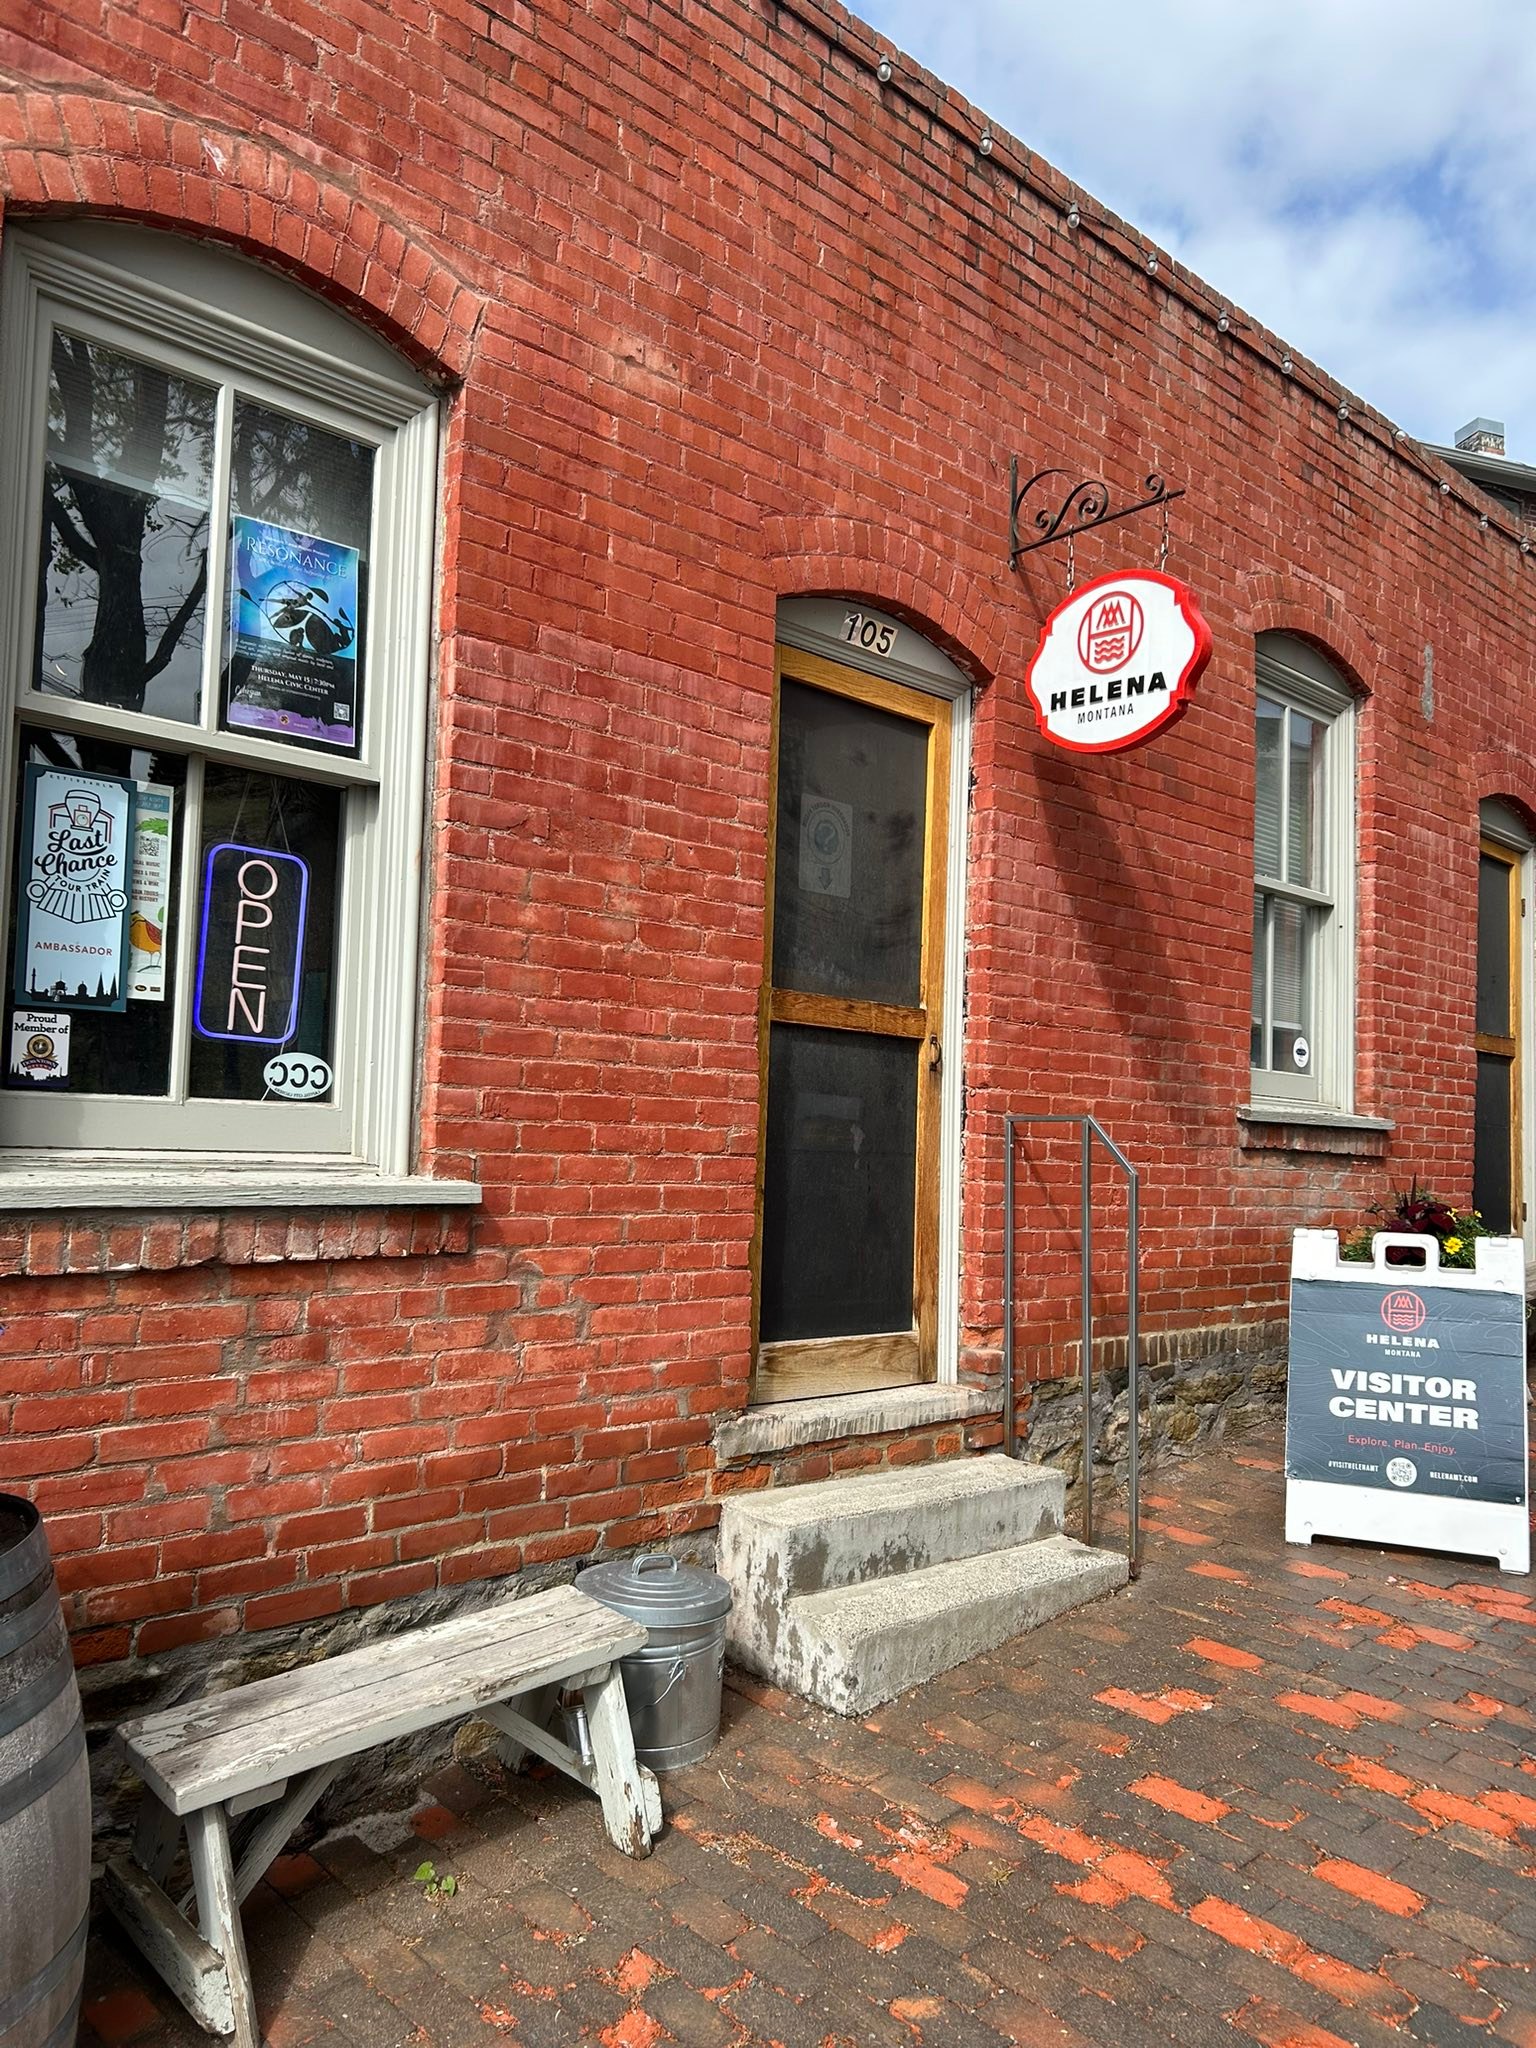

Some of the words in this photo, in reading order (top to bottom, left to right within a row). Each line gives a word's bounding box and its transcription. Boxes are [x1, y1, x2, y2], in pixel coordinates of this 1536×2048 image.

[246, 536, 347, 579] RESONANCE
[846, 613, 895, 654] 105
[257, 674, 285, 686] HELENA
[288, 672, 303, 682] MAY
[1050, 671, 1167, 713] HELENA
[1077, 702, 1135, 725] MONTANA
[47, 829, 107, 856] Last
[34, 852, 118, 878] Chance
[56, 874, 82, 892] TOUR
[86, 868, 111, 892] TRAIN
[34, 941, 113, 956] AMBASSADOR
[227, 859, 279, 1034] OPEN
[14, 1022, 58, 1034] Member
[58, 1024, 70, 1034] of
[27, 1013, 58, 1023] Proud
[1366, 1333, 1441, 1349] HELENA
[1384, 1349, 1422, 1358] MONTANA
[1330, 1368, 1478, 1402] VISITOR
[1328, 1396, 1480, 1430] CENTER
[1348, 1434, 1391, 1448] Explore.
[1423, 1442, 1457, 1456] Enjoy.
[1429, 1471, 1479, 1484] HELENAMT.COM
